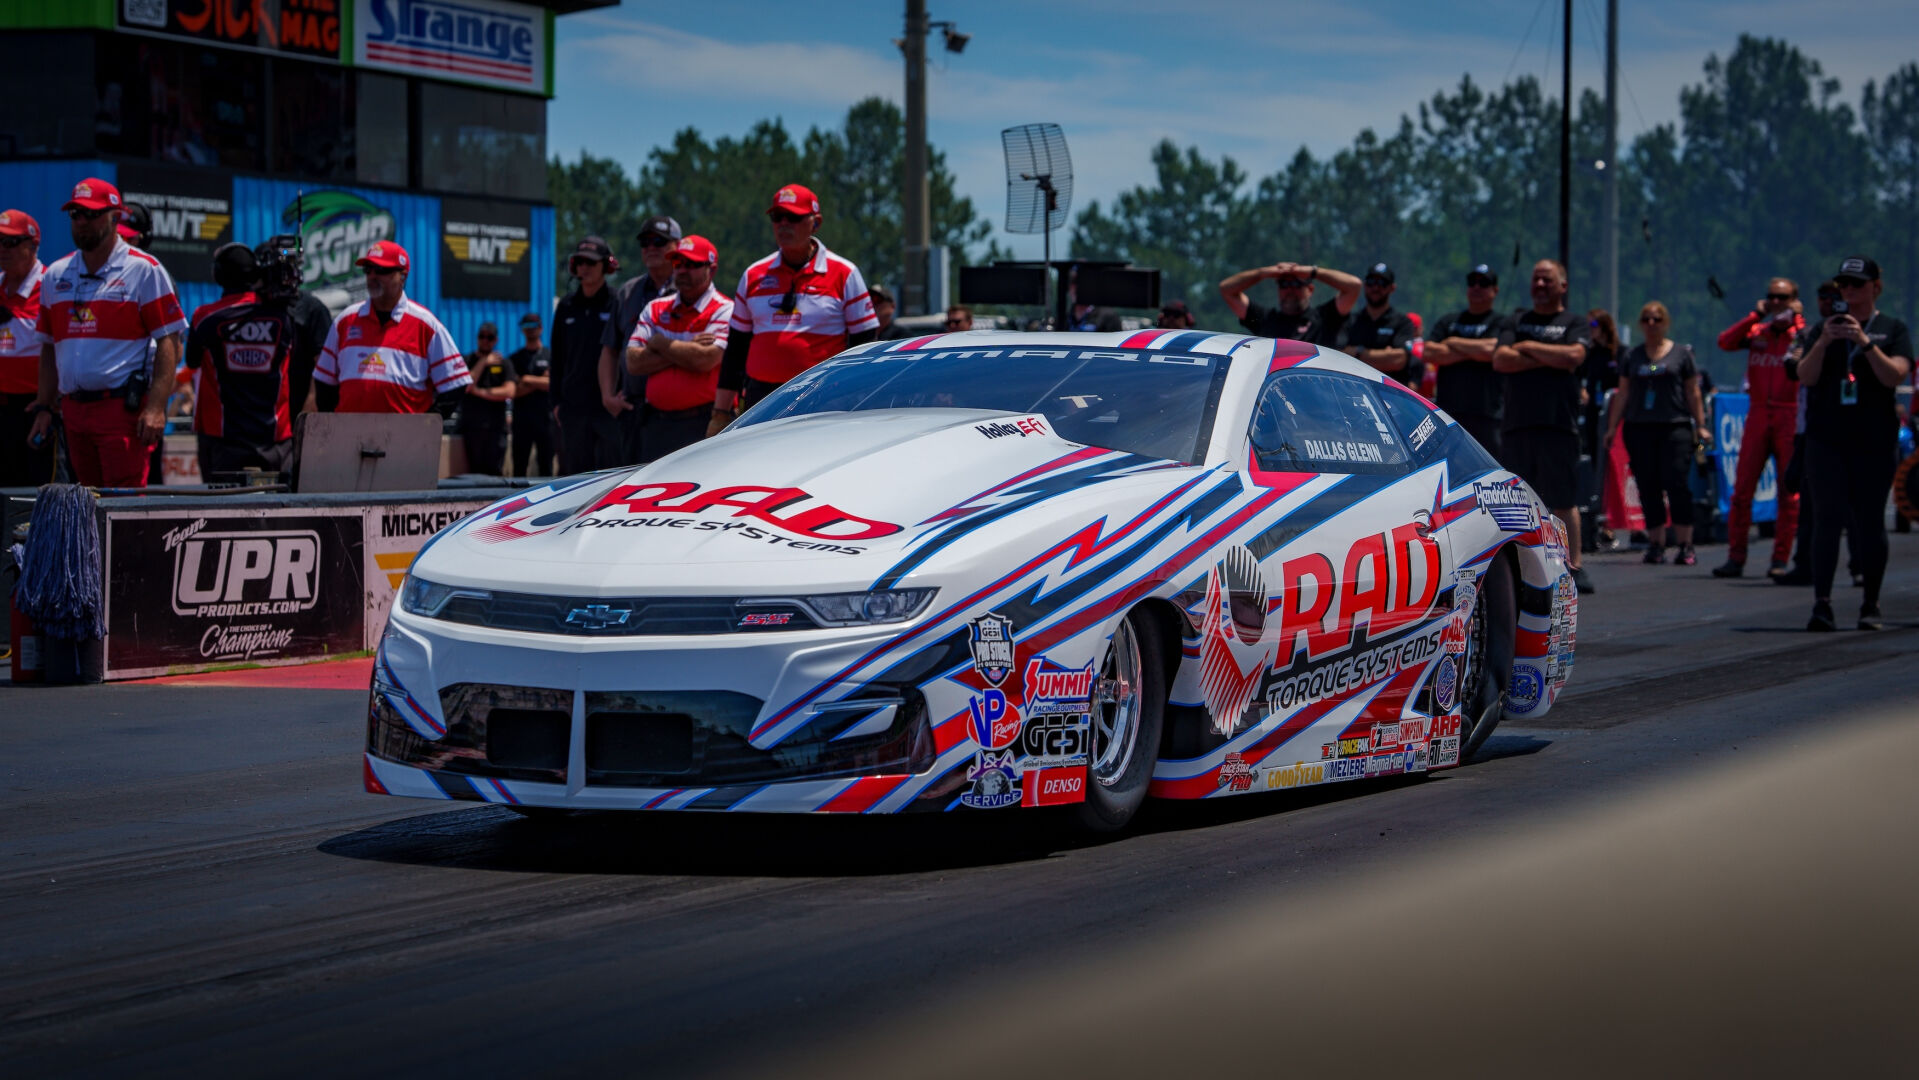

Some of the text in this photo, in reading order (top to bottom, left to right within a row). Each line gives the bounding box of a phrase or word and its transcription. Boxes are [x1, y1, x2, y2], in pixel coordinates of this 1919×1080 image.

[281, 9, 340, 53] MAG
[151, 209, 207, 241] M/T
[468, 236, 512, 265] M/T
[821, 350, 1209, 374] CAMARO
[975, 422, 1026, 440] Holley
[1304, 439, 1383, 463] DALLAS GLENN
[578, 481, 904, 540] RAD
[162, 517, 208, 552] Team
[693, 521, 867, 555] SYSTEMS
[177, 537, 317, 604] UPR
[196, 601, 301, 618] PRODUCTS.COM
[1273, 522, 1441, 671] RAD
[200, 624, 295, 660] Champions
[1446, 643, 1465, 653] TOOLS
[1267, 671, 1353, 713] TORQUE
[1354, 630, 1442, 684] SYSTEMS
[969, 691, 1022, 748] VP Racing
[1056, 703, 1089, 711] EQUIPMENT
[1400, 720, 1424, 741] SIMPSON
[1430, 715, 1461, 738] ARP
[1330, 758, 1366, 777] MEZIERE
[1043, 777, 1082, 794] DENSO
[964, 792, 1021, 808] SERVICE
